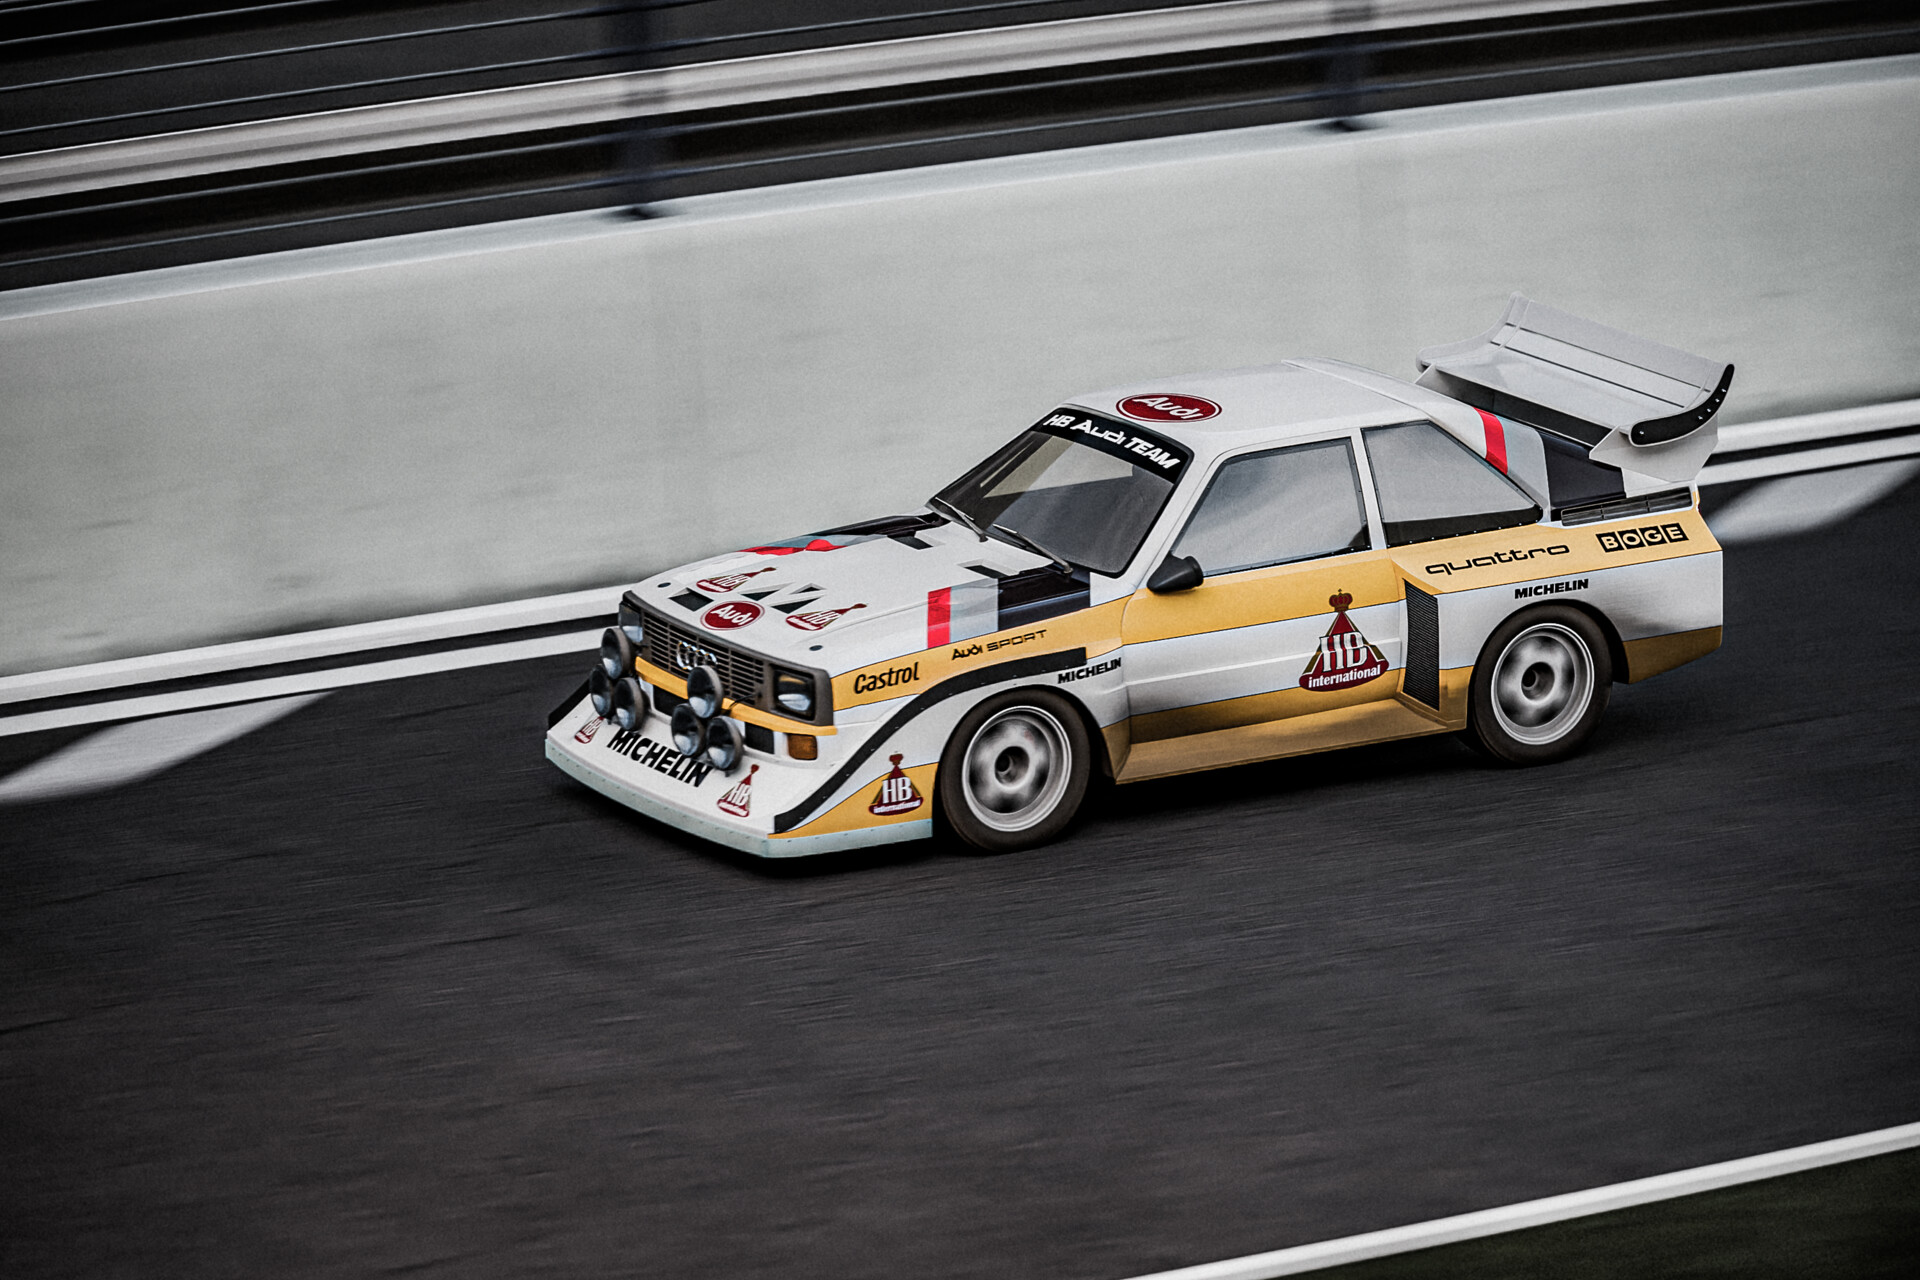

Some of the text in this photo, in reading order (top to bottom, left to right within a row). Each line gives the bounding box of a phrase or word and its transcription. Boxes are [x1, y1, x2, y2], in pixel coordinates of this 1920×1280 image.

[1133, 397, 1203, 419] Audi
[1043, 414, 1181, 469] HB Audi TEAM
[1600, 524, 1686, 552] BOGE
[1425, 544, 1570, 576] quattro
[1514, 578, 1589, 599] MICHELIN
[710, 605, 754, 626] Audi
[951, 629, 1047, 660] Audi SPORT
[1319, 631, 1368, 672] HB
[854, 662, 920, 694] Castrol
[1057, 657, 1122, 684] MICHELIN
[1308, 664, 1381, 688] international
[607, 727, 714, 788] MICHELIN
[727, 783, 751, 806] HB
[882, 776, 913, 804] HB
